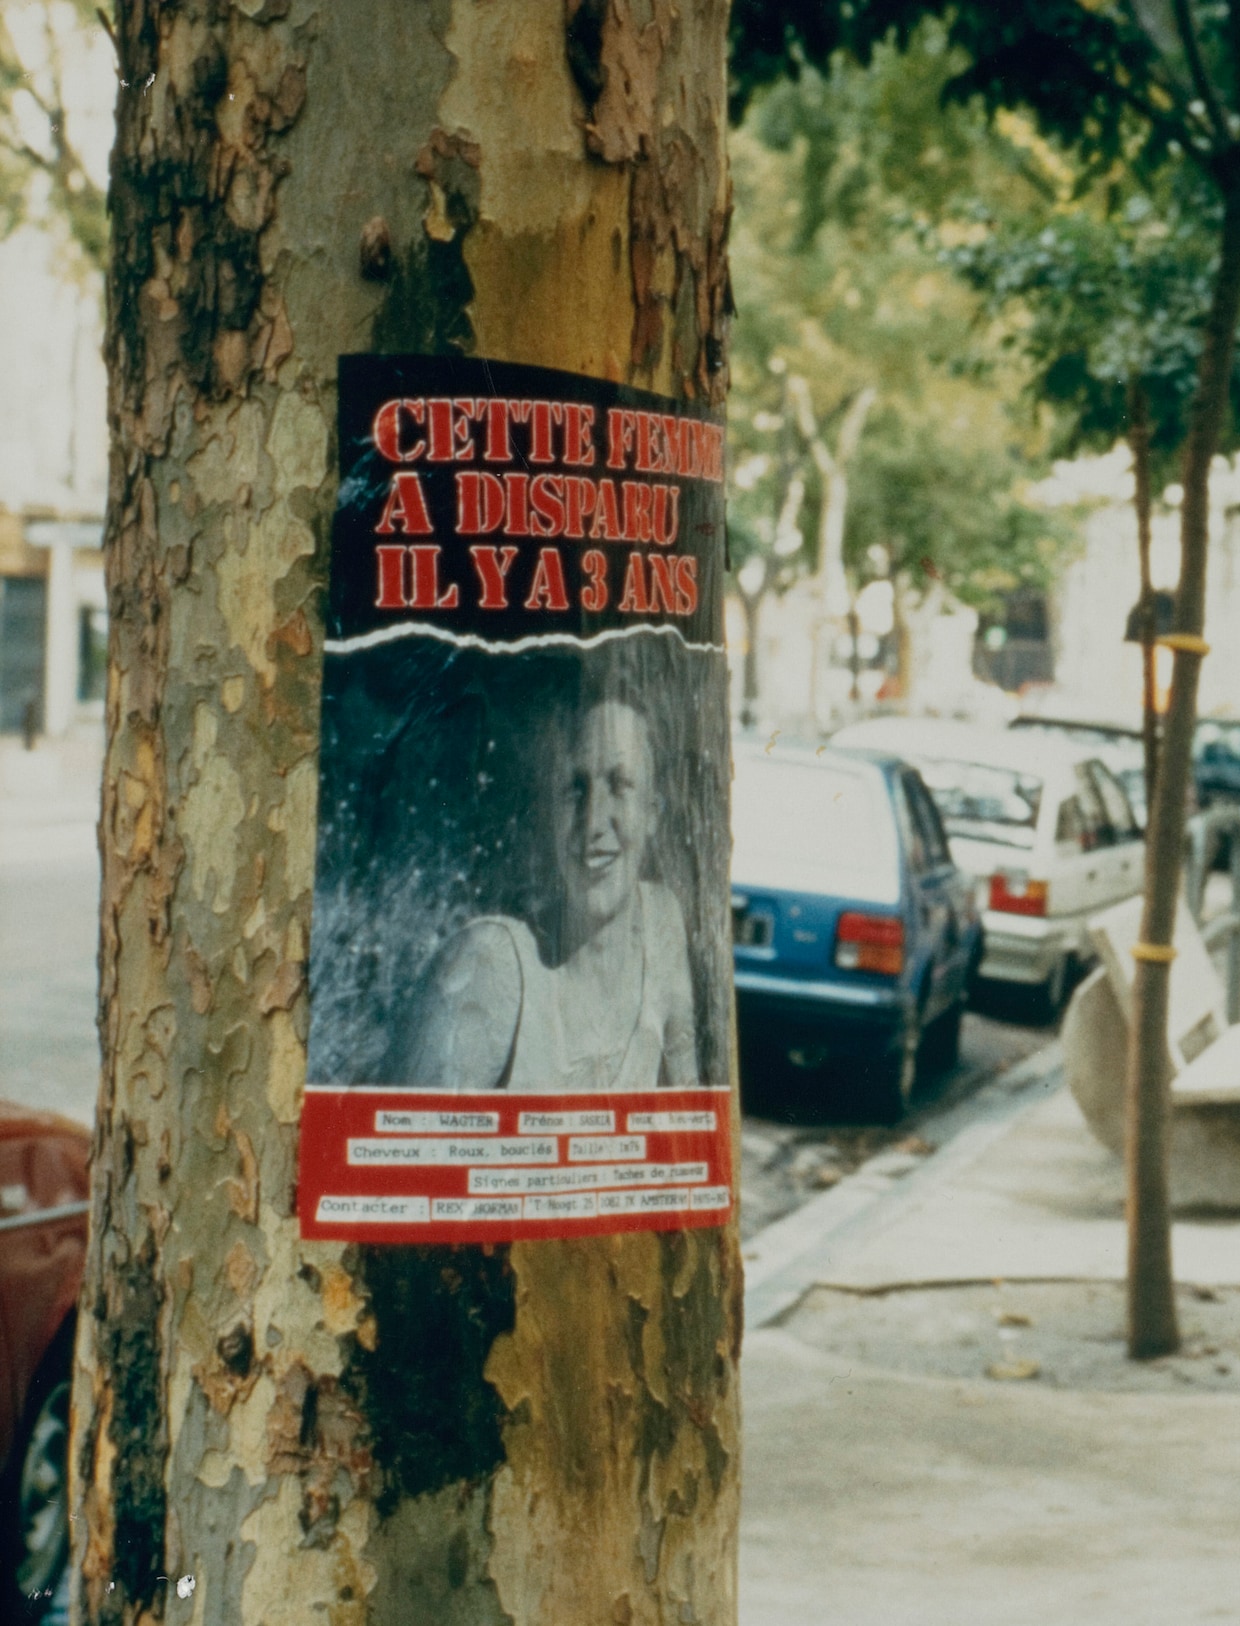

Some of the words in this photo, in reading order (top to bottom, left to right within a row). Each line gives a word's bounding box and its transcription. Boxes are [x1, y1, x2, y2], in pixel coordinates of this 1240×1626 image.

[373, 398, 596, 465] CETTE
[607, 408, 725, 483] FEMME
[375, 471, 434, 535] A
[455, 471, 681, 546] DISPARU
[375, 545, 459, 608] IL
[470, 546, 518, 608] Y
[525, 547, 569, 610] A
[581, 550, 608, 612] 3
[618, 552, 698, 616] ANS
[381, 1114, 412, 1126] Nom
[353, 1145, 420, 1159] Cheveux
[449, 1144, 490, 1158] Roux,
[500, 1142, 553, 1156] bouclés
[473, 1175, 520, 1189] Signes
[527, 1172, 598, 1188] particuliers
[651, 1168, 665, 1178] de
[320, 1199, 408, 1215] Contacter
[436, 1202, 464, 1214] REX
